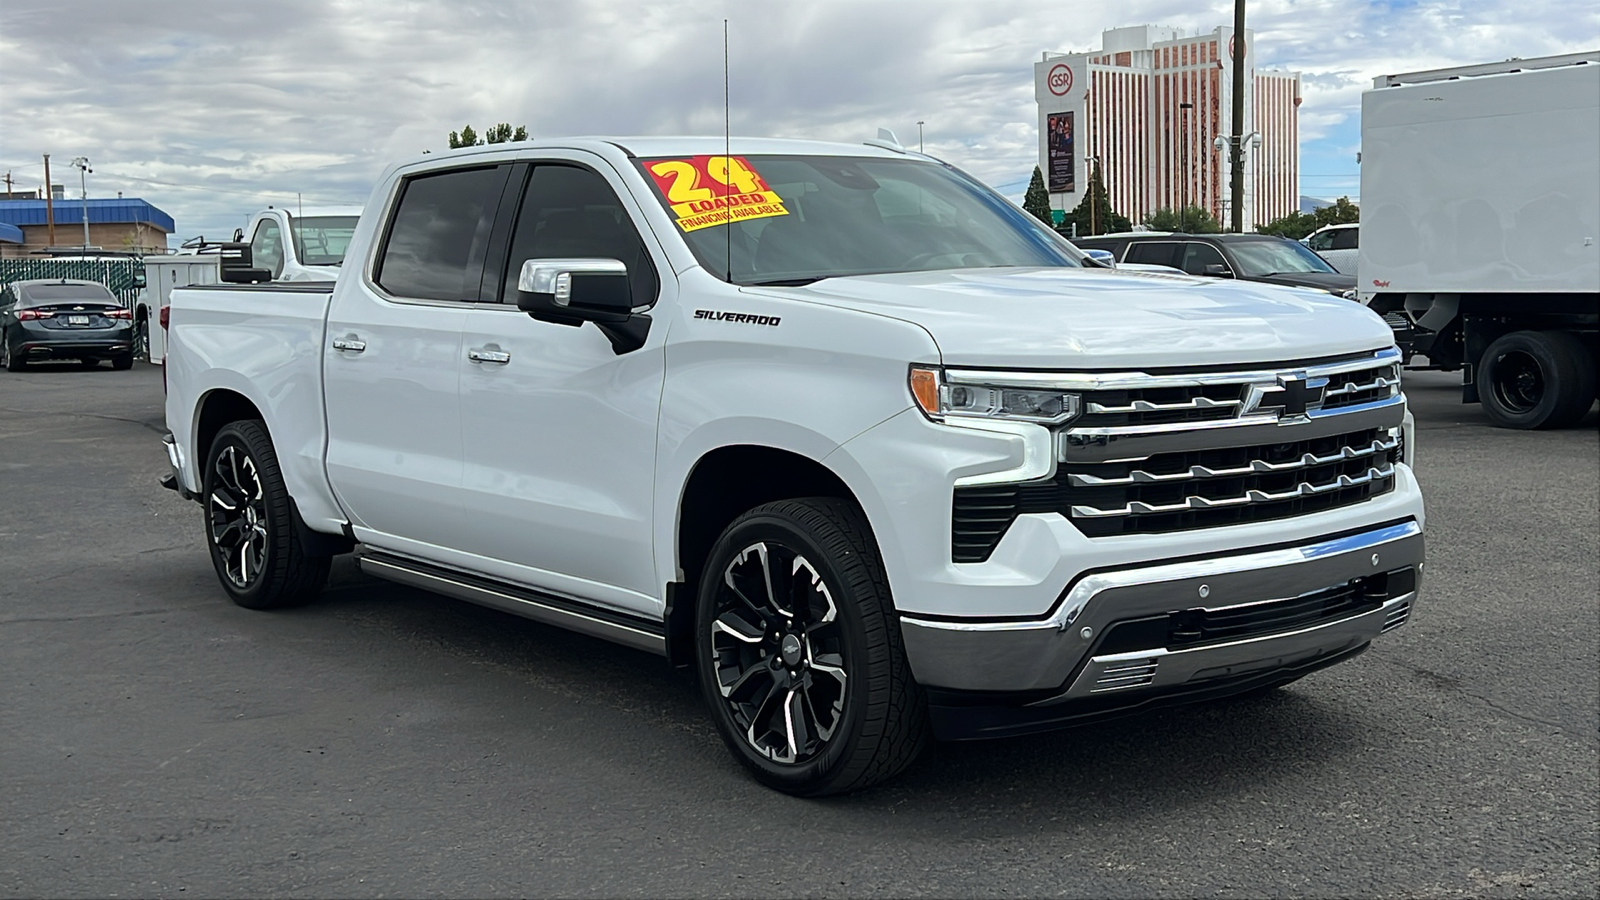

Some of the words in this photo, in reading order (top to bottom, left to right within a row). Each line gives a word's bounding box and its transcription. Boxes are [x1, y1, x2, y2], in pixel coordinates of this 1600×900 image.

[1051, 72, 1069, 87] GSR
[650, 156, 758, 202] 24
[689, 193, 766, 213] LOADED
[680, 211, 734, 229] FINANCING
[733, 204, 783, 218] AVAILABLE
[694, 309, 781, 326] SILVERADO
